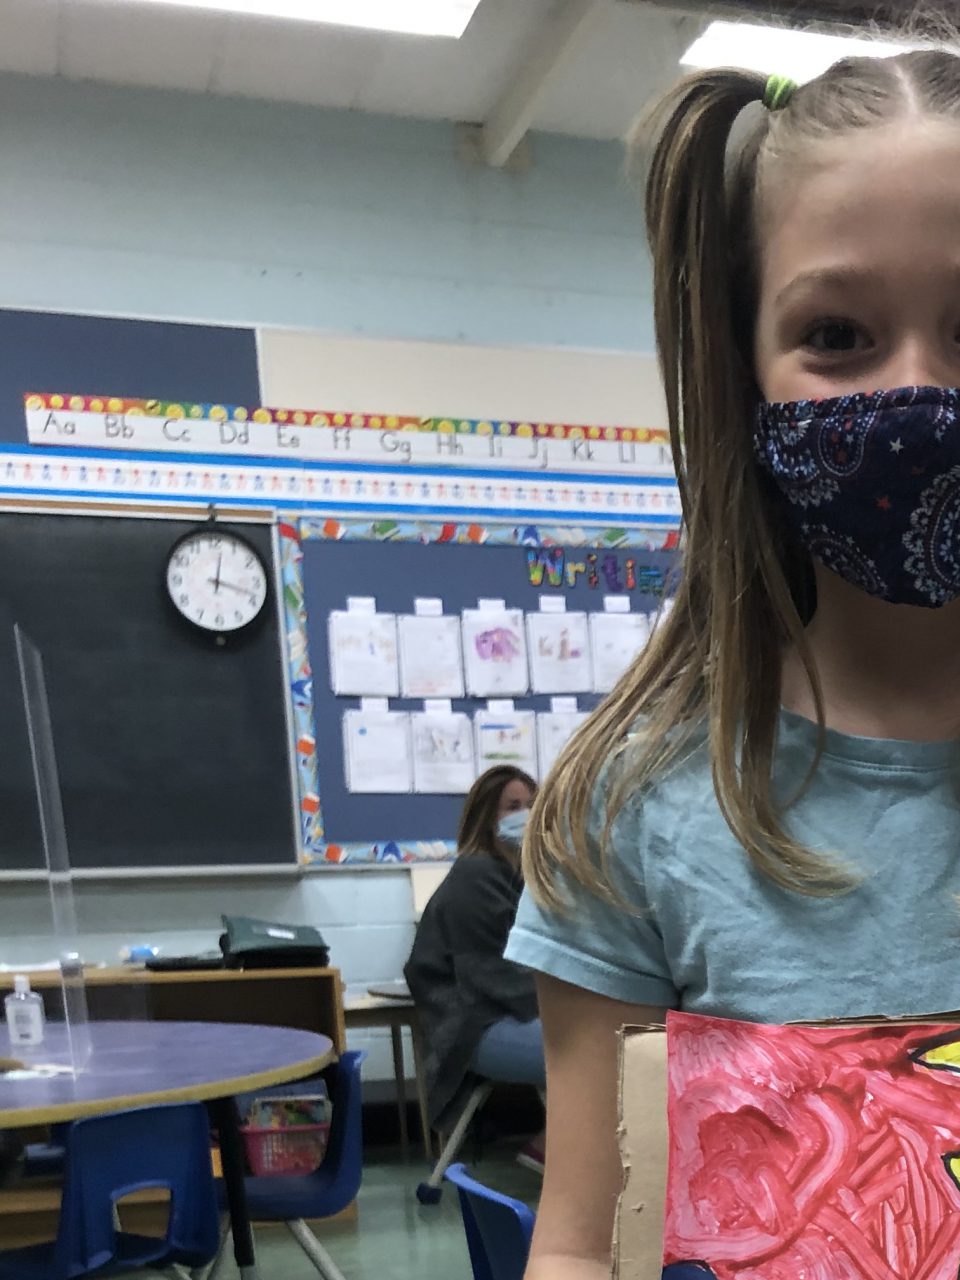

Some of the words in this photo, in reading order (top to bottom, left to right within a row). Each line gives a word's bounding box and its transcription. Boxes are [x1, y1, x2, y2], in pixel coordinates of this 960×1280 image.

[43, 412, 76, 435] Aa
[105, 414, 134, 438] Bb
[162, 418, 192, 442] Cc
[219, 422, 249, 445] Dd
[277, 424, 300, 448] Ee
[380, 431, 412, 463] Gg
[436, 433, 464, 455] Hh
[528, 438, 548, 469] Jj
